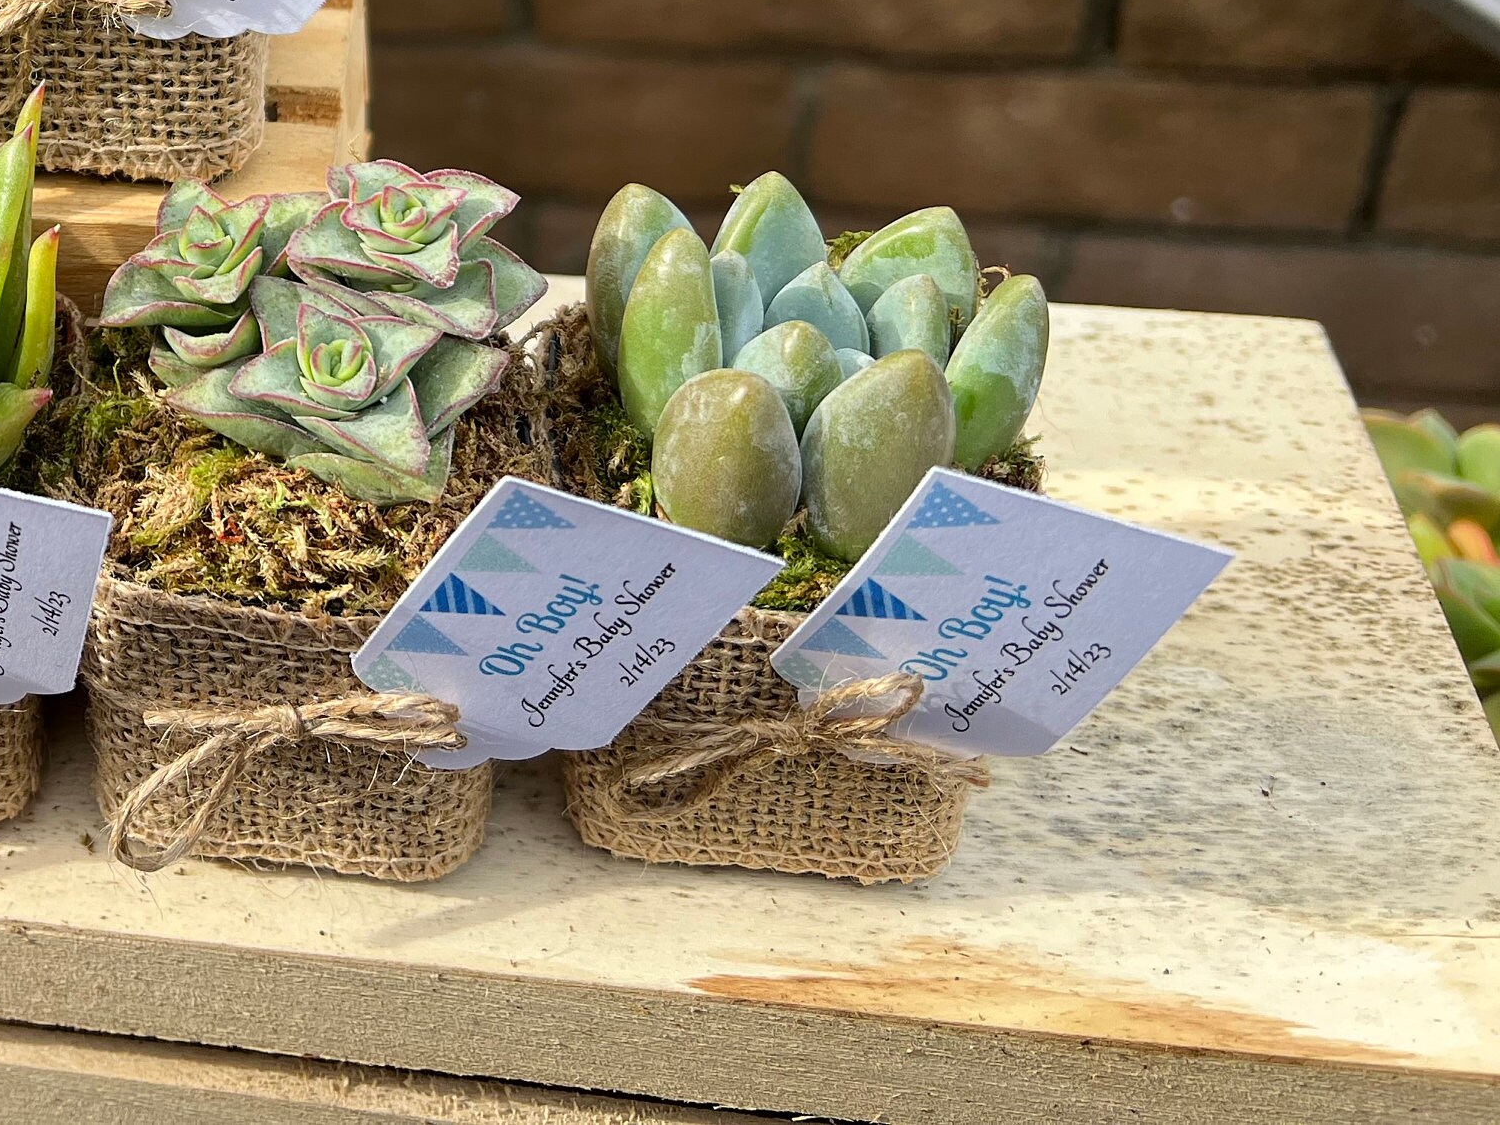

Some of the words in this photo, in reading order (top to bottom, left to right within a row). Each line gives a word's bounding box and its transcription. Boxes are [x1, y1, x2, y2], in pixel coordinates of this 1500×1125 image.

[31, 591, 71, 636] 2/14/23
[479, 643, 543, 676] Oh
[516, 573, 603, 635] Boy!
[520, 660, 586, 729] Jennifer's
[574, 613, 632, 660] Baby
[615, 562, 677, 616] Shower
[620, 637, 676, 688] 2/14/23
[898, 651, 968, 682] Oh
[938, 574, 1032, 641] Boy!
[942, 668, 1015, 733] Jennifer's
[1000, 617, 1064, 666] Baby
[1044, 558, 1110, 619] Shower
[1052, 643, 1111, 696] 2/14/23
